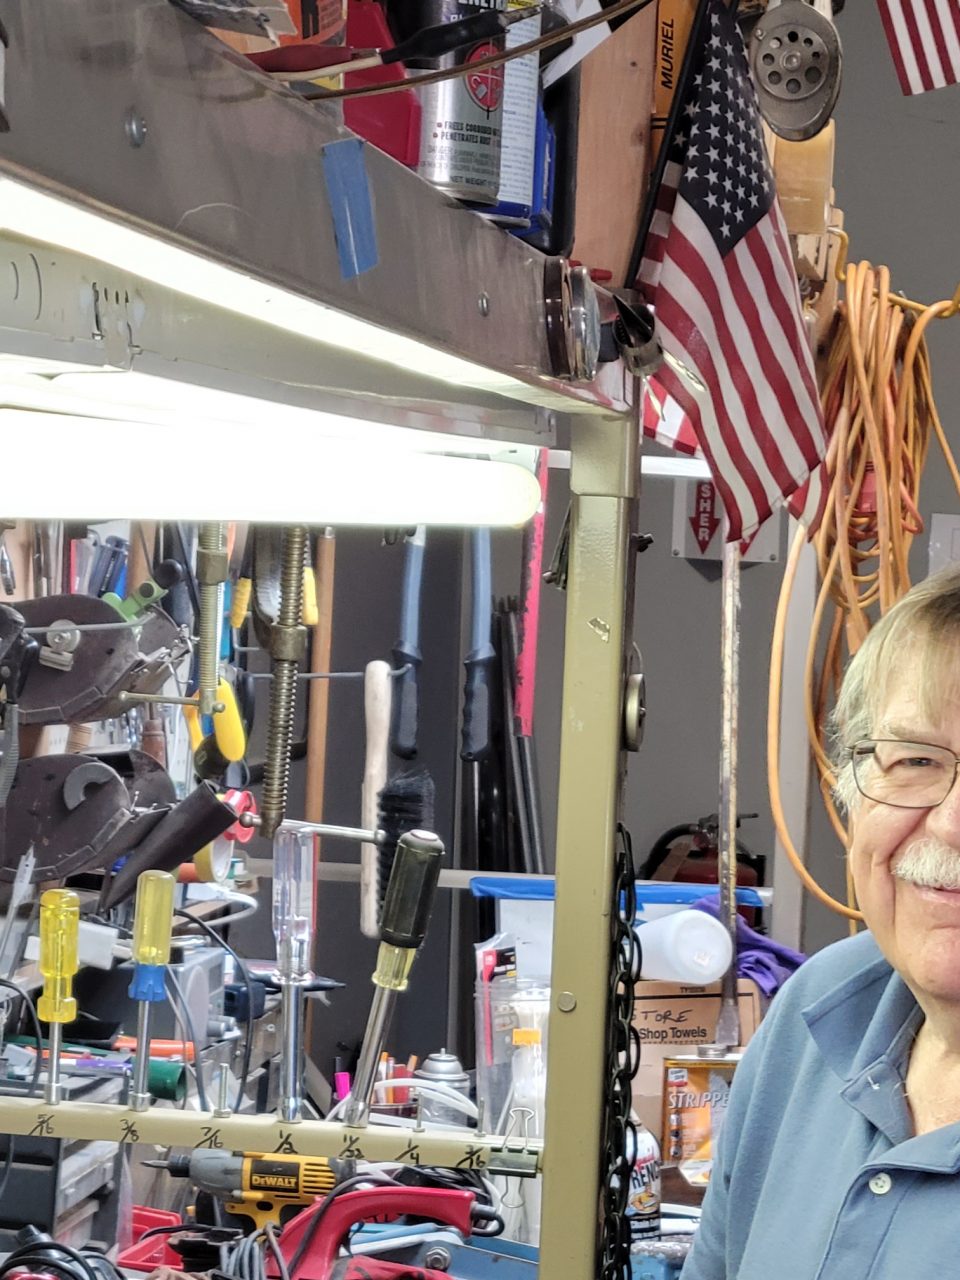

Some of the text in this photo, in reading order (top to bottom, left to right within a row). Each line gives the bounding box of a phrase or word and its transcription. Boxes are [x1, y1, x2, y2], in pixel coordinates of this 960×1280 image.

[661, 18, 674, 90] MURIEL
[698, 484, 712, 541] SHER
[639, 1027, 668, 1042] Shop
[669, 1025, 707, 1038] Towels
[668, 1091, 730, 1109] STRIPPE
[119, 1118, 140, 1143] 3/8
[193, 1126, 224, 1149] 7/16
[395, 1138, 420, 1164] 1/4
